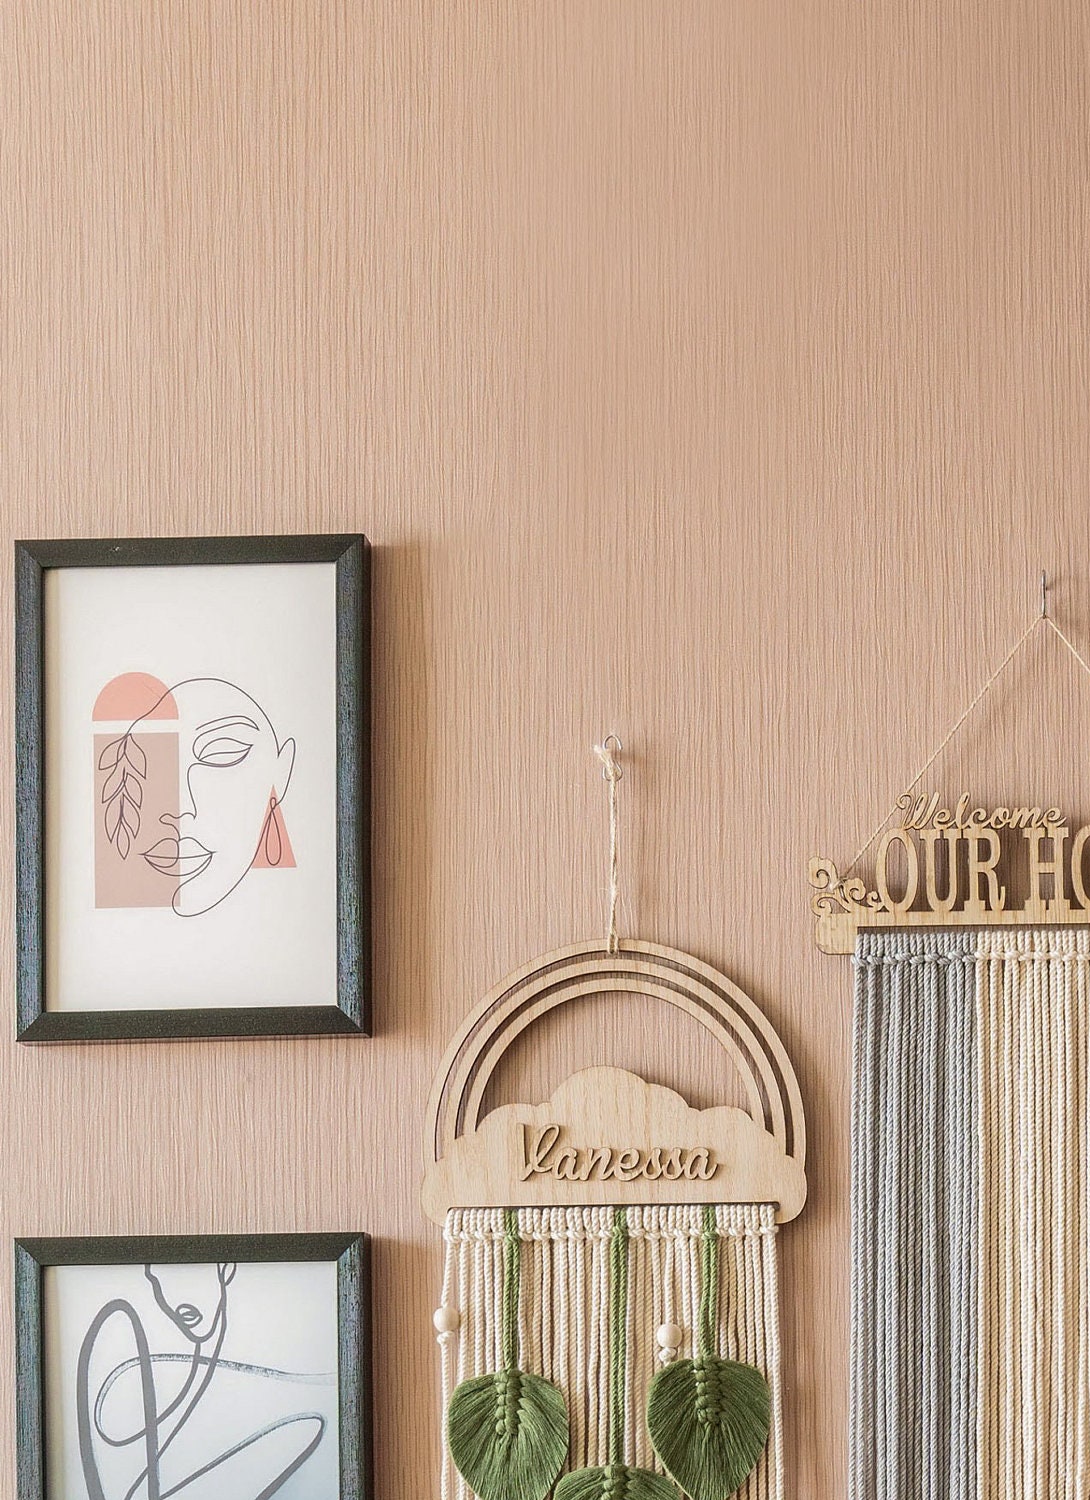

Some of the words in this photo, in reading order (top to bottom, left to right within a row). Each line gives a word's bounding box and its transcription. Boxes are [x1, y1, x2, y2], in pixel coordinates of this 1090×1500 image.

[897, 791, 1066, 829] Welcome
[876, 826, 1006, 911] OUR
[520, 1122, 719, 1182] Vanessa
